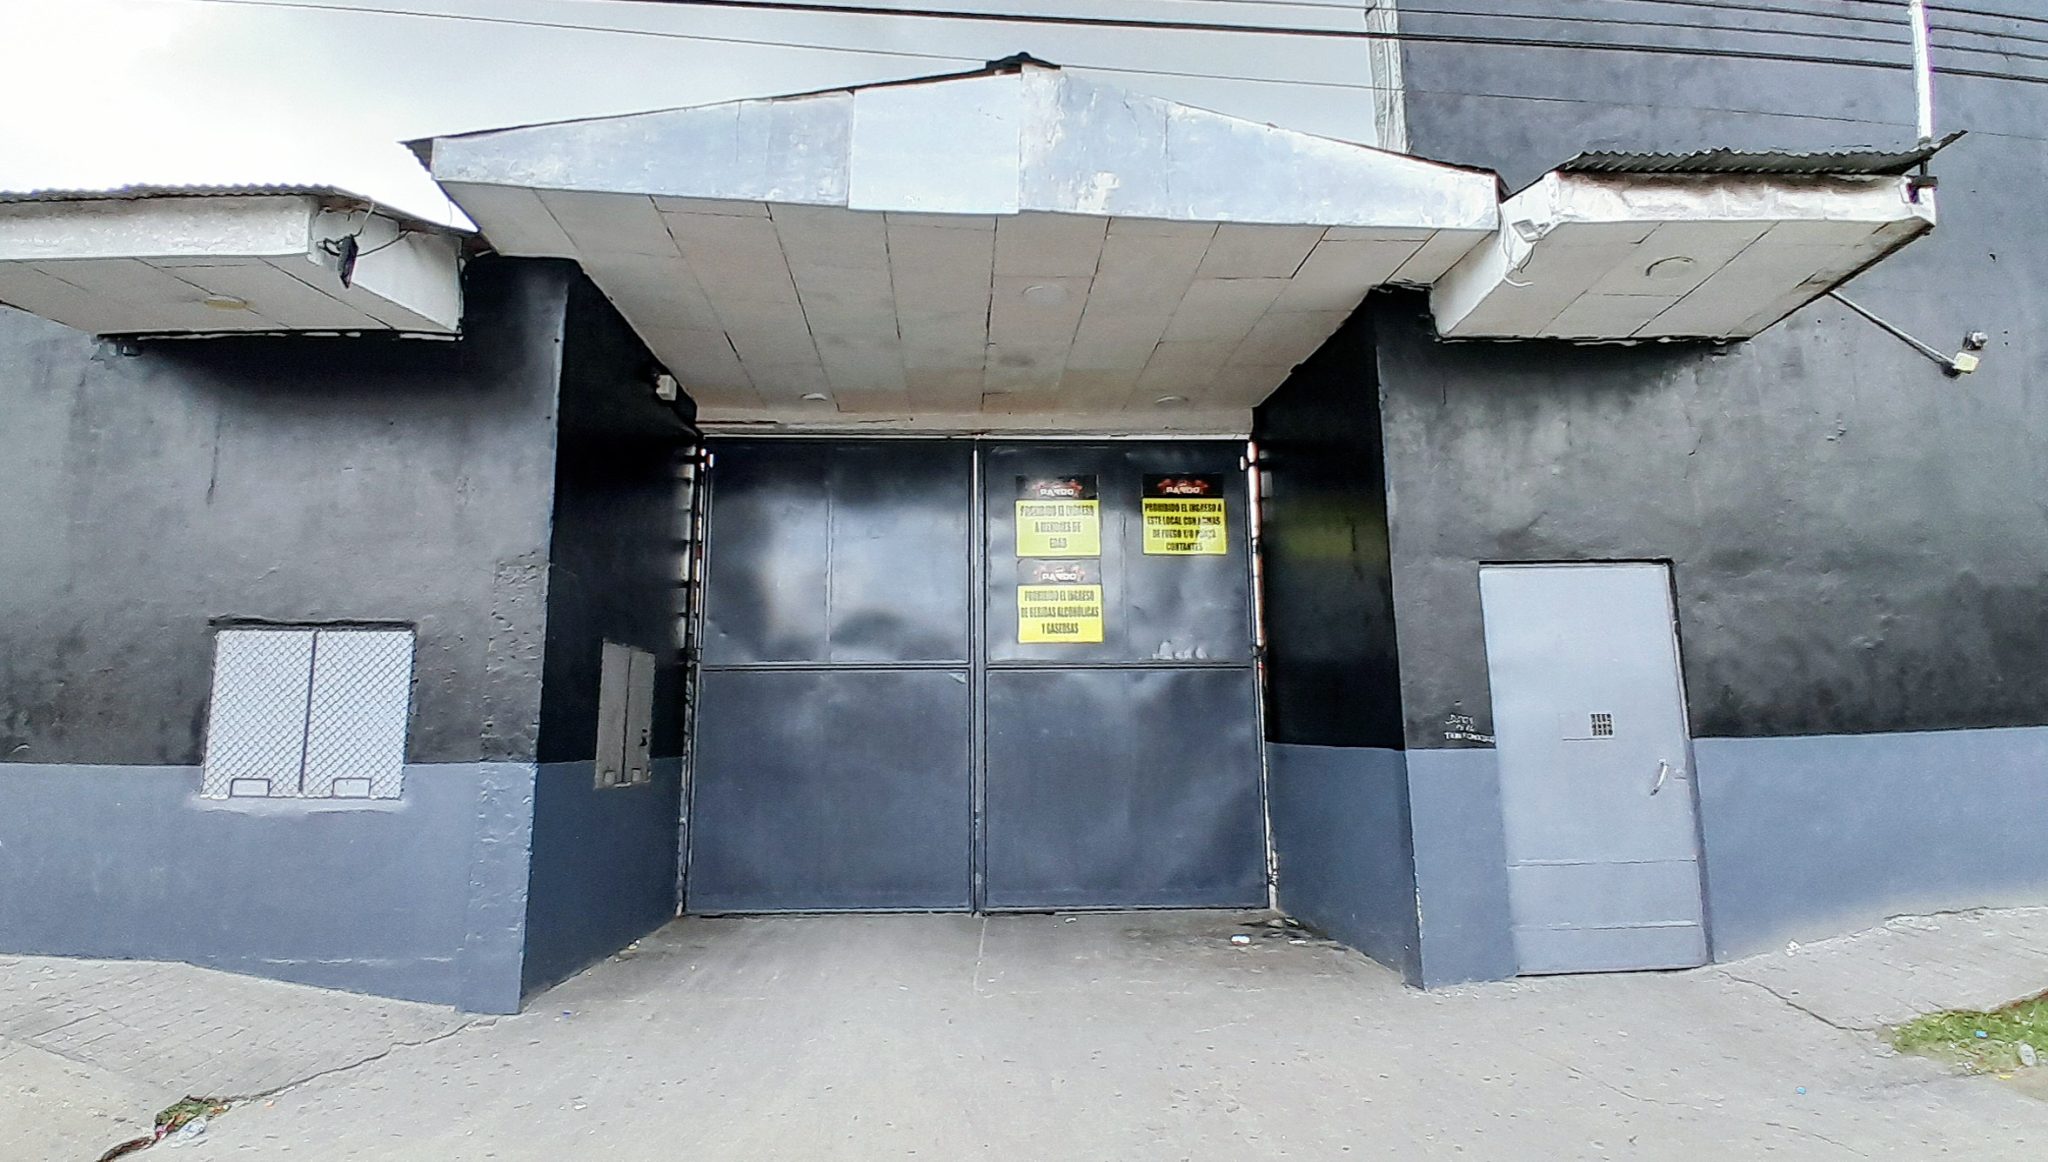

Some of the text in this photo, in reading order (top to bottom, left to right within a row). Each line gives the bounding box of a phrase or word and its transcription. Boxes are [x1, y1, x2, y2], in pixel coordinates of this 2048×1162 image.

[1145, 503, 1222, 512] PROHIBIDO EL INGRESO A
[1147, 516, 1161, 525] ESTE
[1163, 516, 1182, 525] LOCAL
[1184, 516, 1196, 525] CON
[1025, 591, 1094, 601] PROHIBIDO EL INGRESO
[1021, 607, 1028, 617] DE
[1030, 607, 1056, 617] BEBIDAS
[1047, 623, 1079, 634] GASEOSAS
